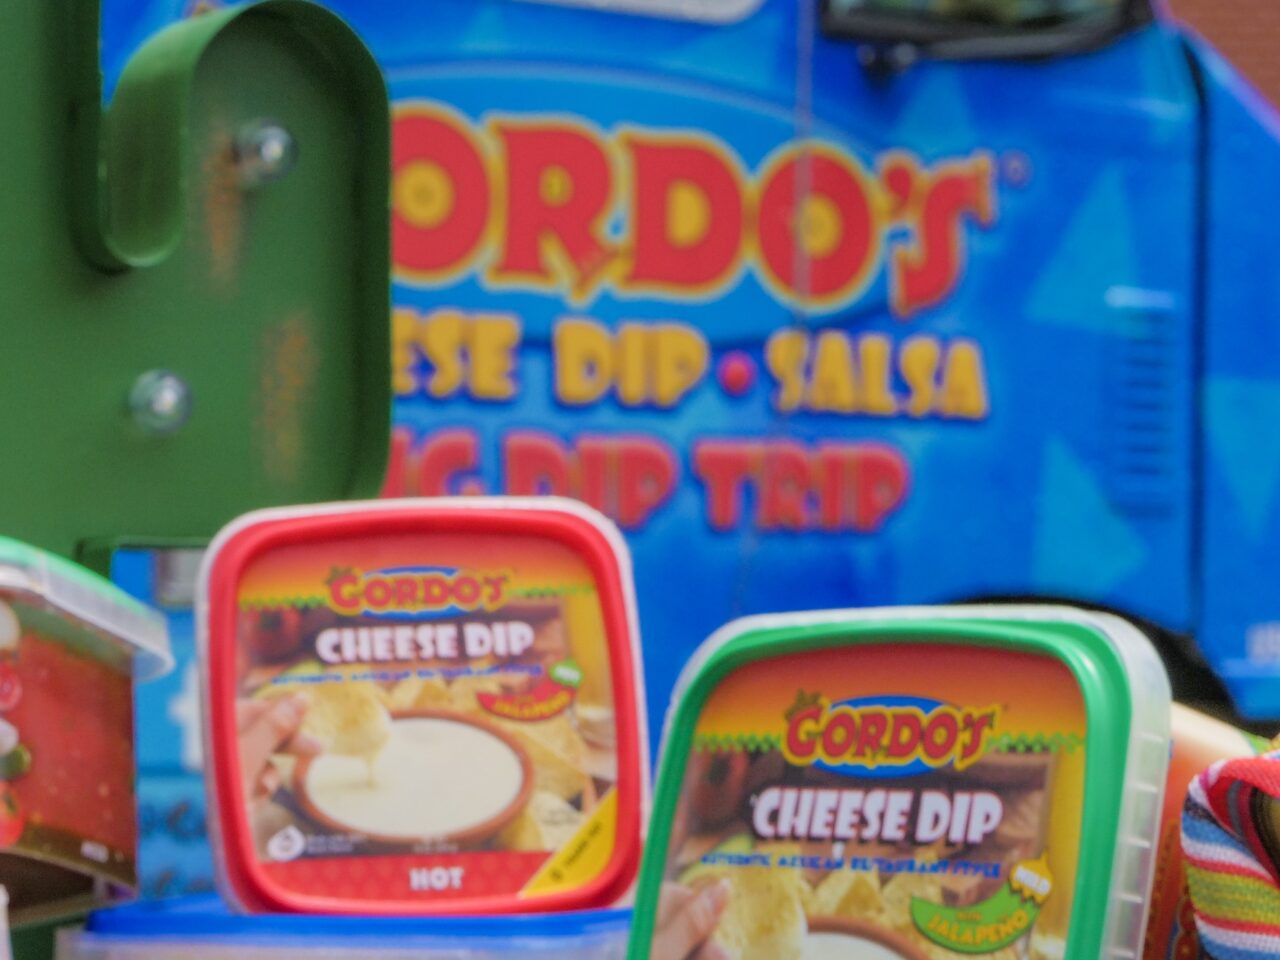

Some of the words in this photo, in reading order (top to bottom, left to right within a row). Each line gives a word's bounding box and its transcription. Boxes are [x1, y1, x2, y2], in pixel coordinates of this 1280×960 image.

[555, 318, 709, 407] DIP
[766, 328, 988, 420] SALSA
[504, 431, 676, 530] DIP
[693, 438, 911, 532] TRIP
[328, 568, 516, 616] GORDO'S
[315, 624, 459, 664] CHEESE
[463, 620, 535, 658] DIP
[783, 702, 1000, 772] GORDO'S
[753, 787, 915, 843] CHEESE
[915, 791, 1003, 845] DIP
[408, 866, 464, 891] HOT
